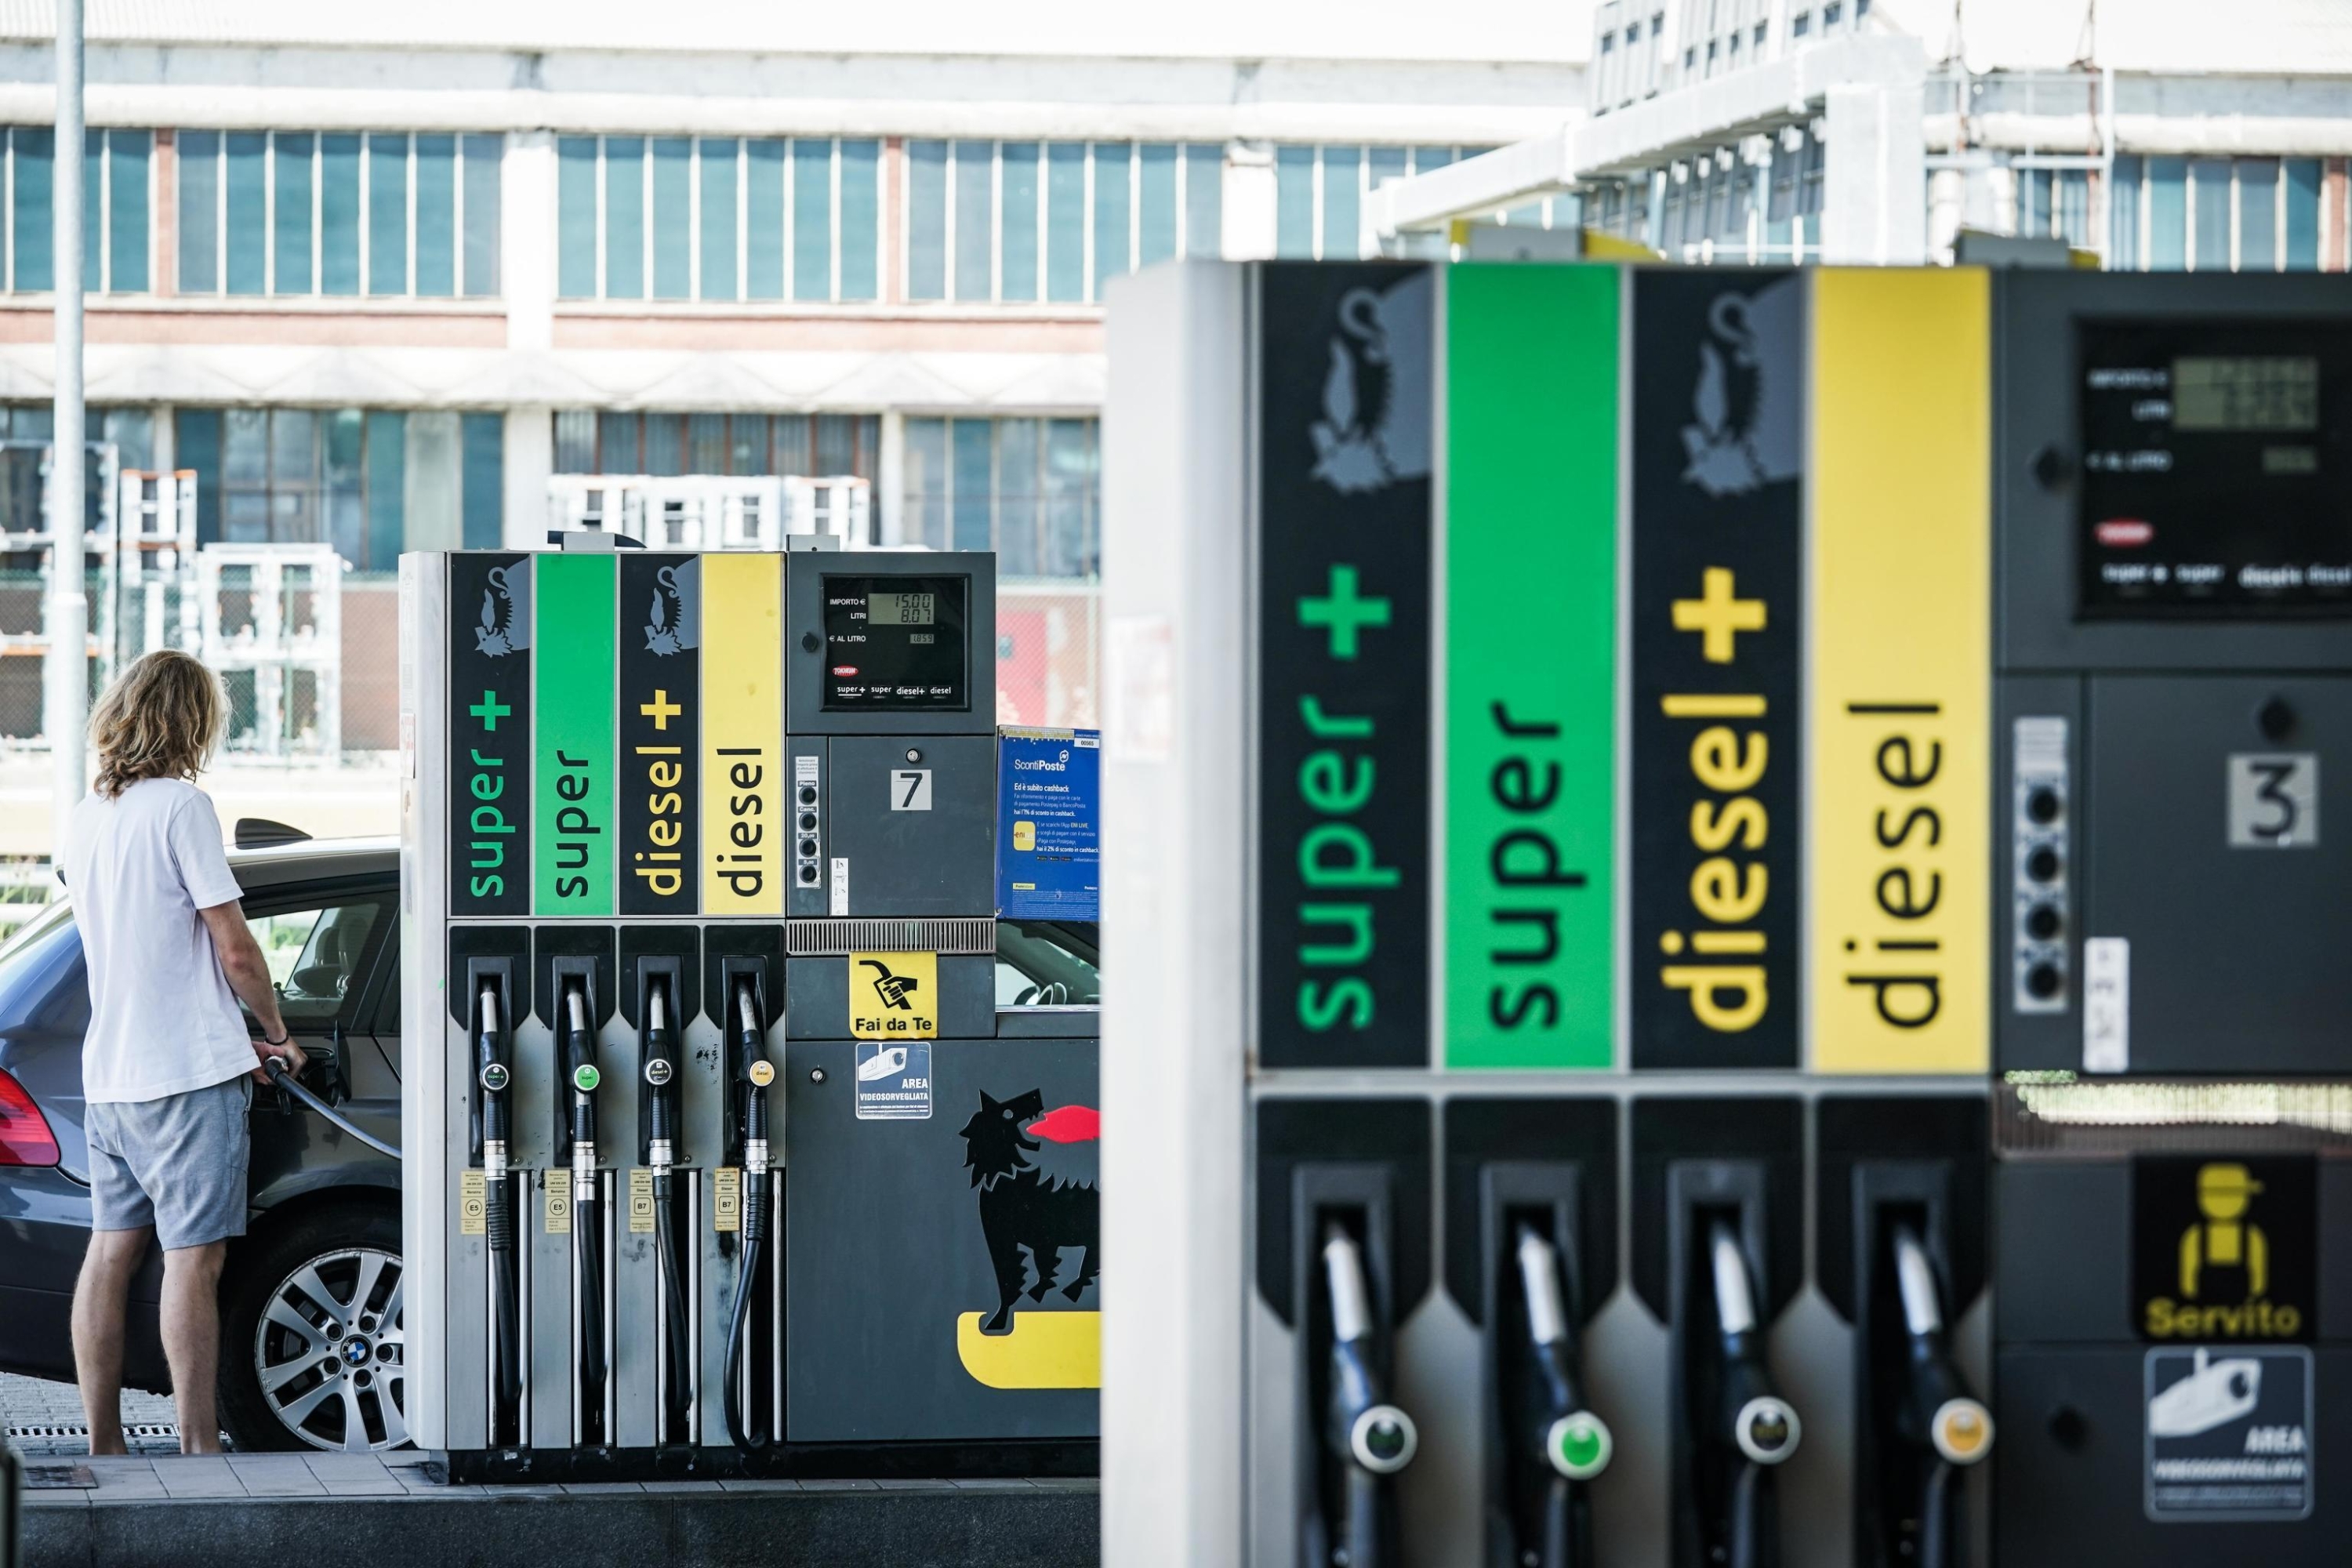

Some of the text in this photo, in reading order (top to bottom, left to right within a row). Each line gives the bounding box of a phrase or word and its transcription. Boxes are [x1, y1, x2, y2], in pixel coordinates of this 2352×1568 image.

[895, 594, 931, 608] 15,00
[901, 609, 931, 623] 8,07
[900, 772, 923, 808] 7
[1014, 759, 1065, 771] ScontiPoste
[2249, 762, 2296, 839] 3
[470, 749, 516, 897] super
[556, 750, 601, 898] super
[635, 746, 682, 896] diesel
[717, 748, 763, 897] diesel
[1298, 695, 1401, 1030] super
[1490, 700, 1587, 1030] super
[1661, 695, 1768, 1032] diesel
[1845, 703, 1941, 1029] diesel
[855, 1018, 932, 1031] Fai da Te
[859, 1092, 928, 1101] VIDEOSORVEGLIATA
[902, 1078, 928, 1089] AREA
[2146, 1298, 2300, 1336] Servito
